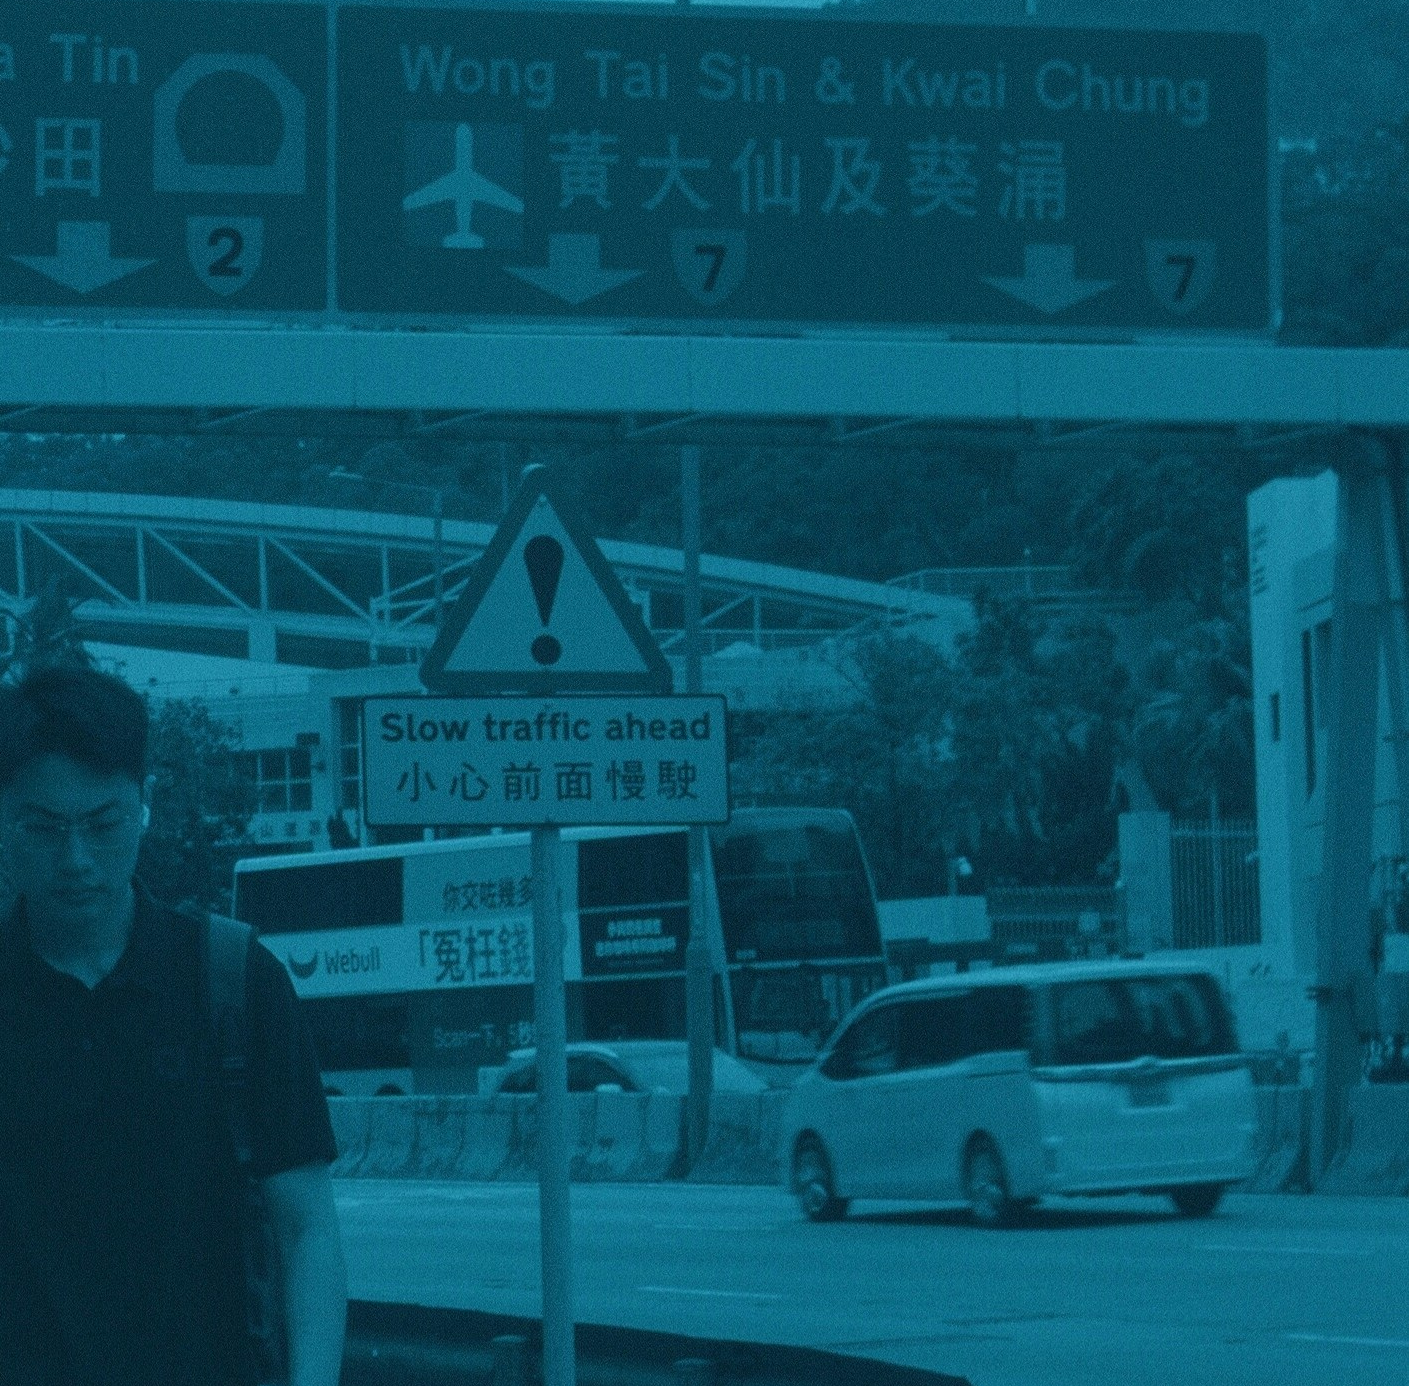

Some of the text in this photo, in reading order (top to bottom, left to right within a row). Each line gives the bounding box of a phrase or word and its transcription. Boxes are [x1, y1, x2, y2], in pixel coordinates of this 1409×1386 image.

[50, 33, 138, 83] Tin
[401, 45, 1208, 125] Wong Tai Sin & Kwai Chung
[550, 130, 1065, 219] 黃大仙及葵涌
[209, 228, 243, 276] 2
[695, 245, 726, 291] 7
[1167, 256, 1195, 300] 7
[382, 713, 710, 742] Slow traffic ahead
[398, 761, 696, 802] 小心前面慢駛
[324, 947, 382, 975] Webull
